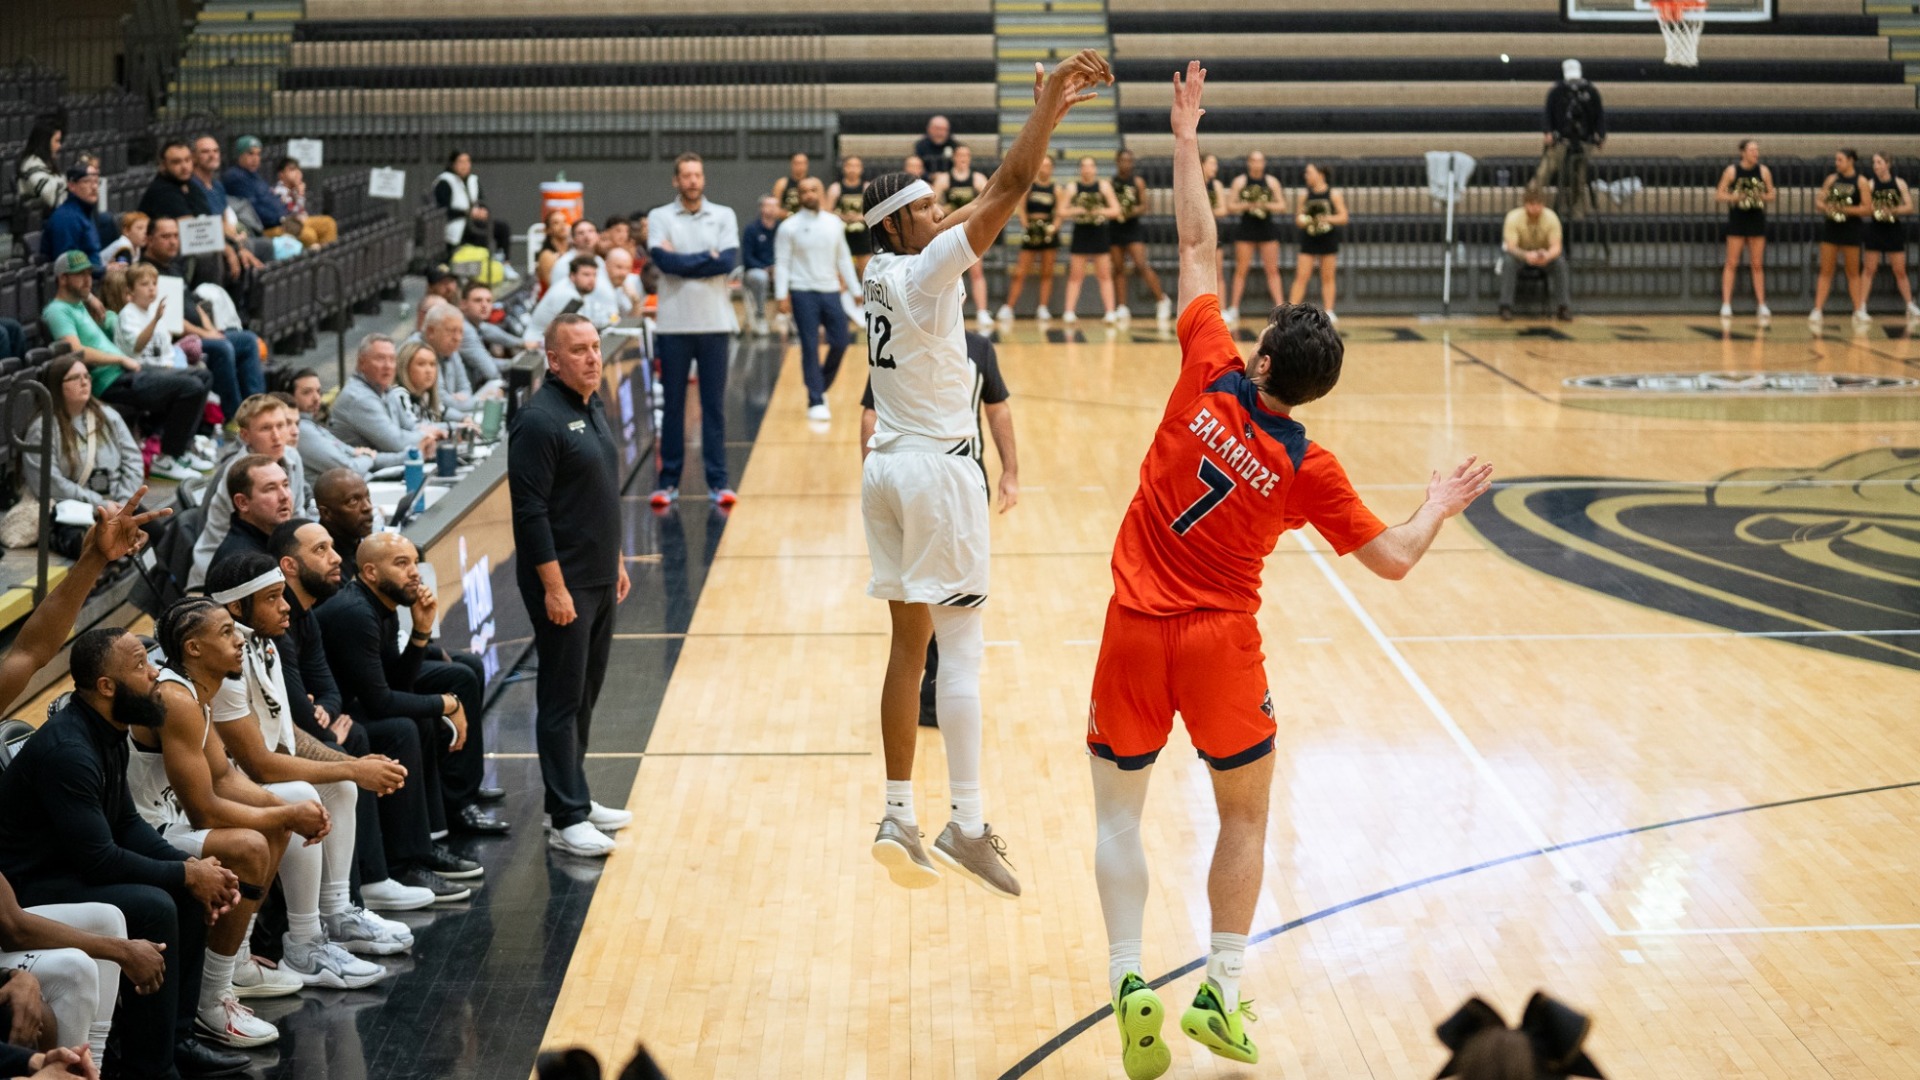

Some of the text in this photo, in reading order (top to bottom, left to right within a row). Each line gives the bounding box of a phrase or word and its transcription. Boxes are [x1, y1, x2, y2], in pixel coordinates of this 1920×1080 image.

[865, 311, 896, 370] 12
[1188, 407, 1281, 498] SALARIDZE
[1169, 454, 1238, 537] 7
